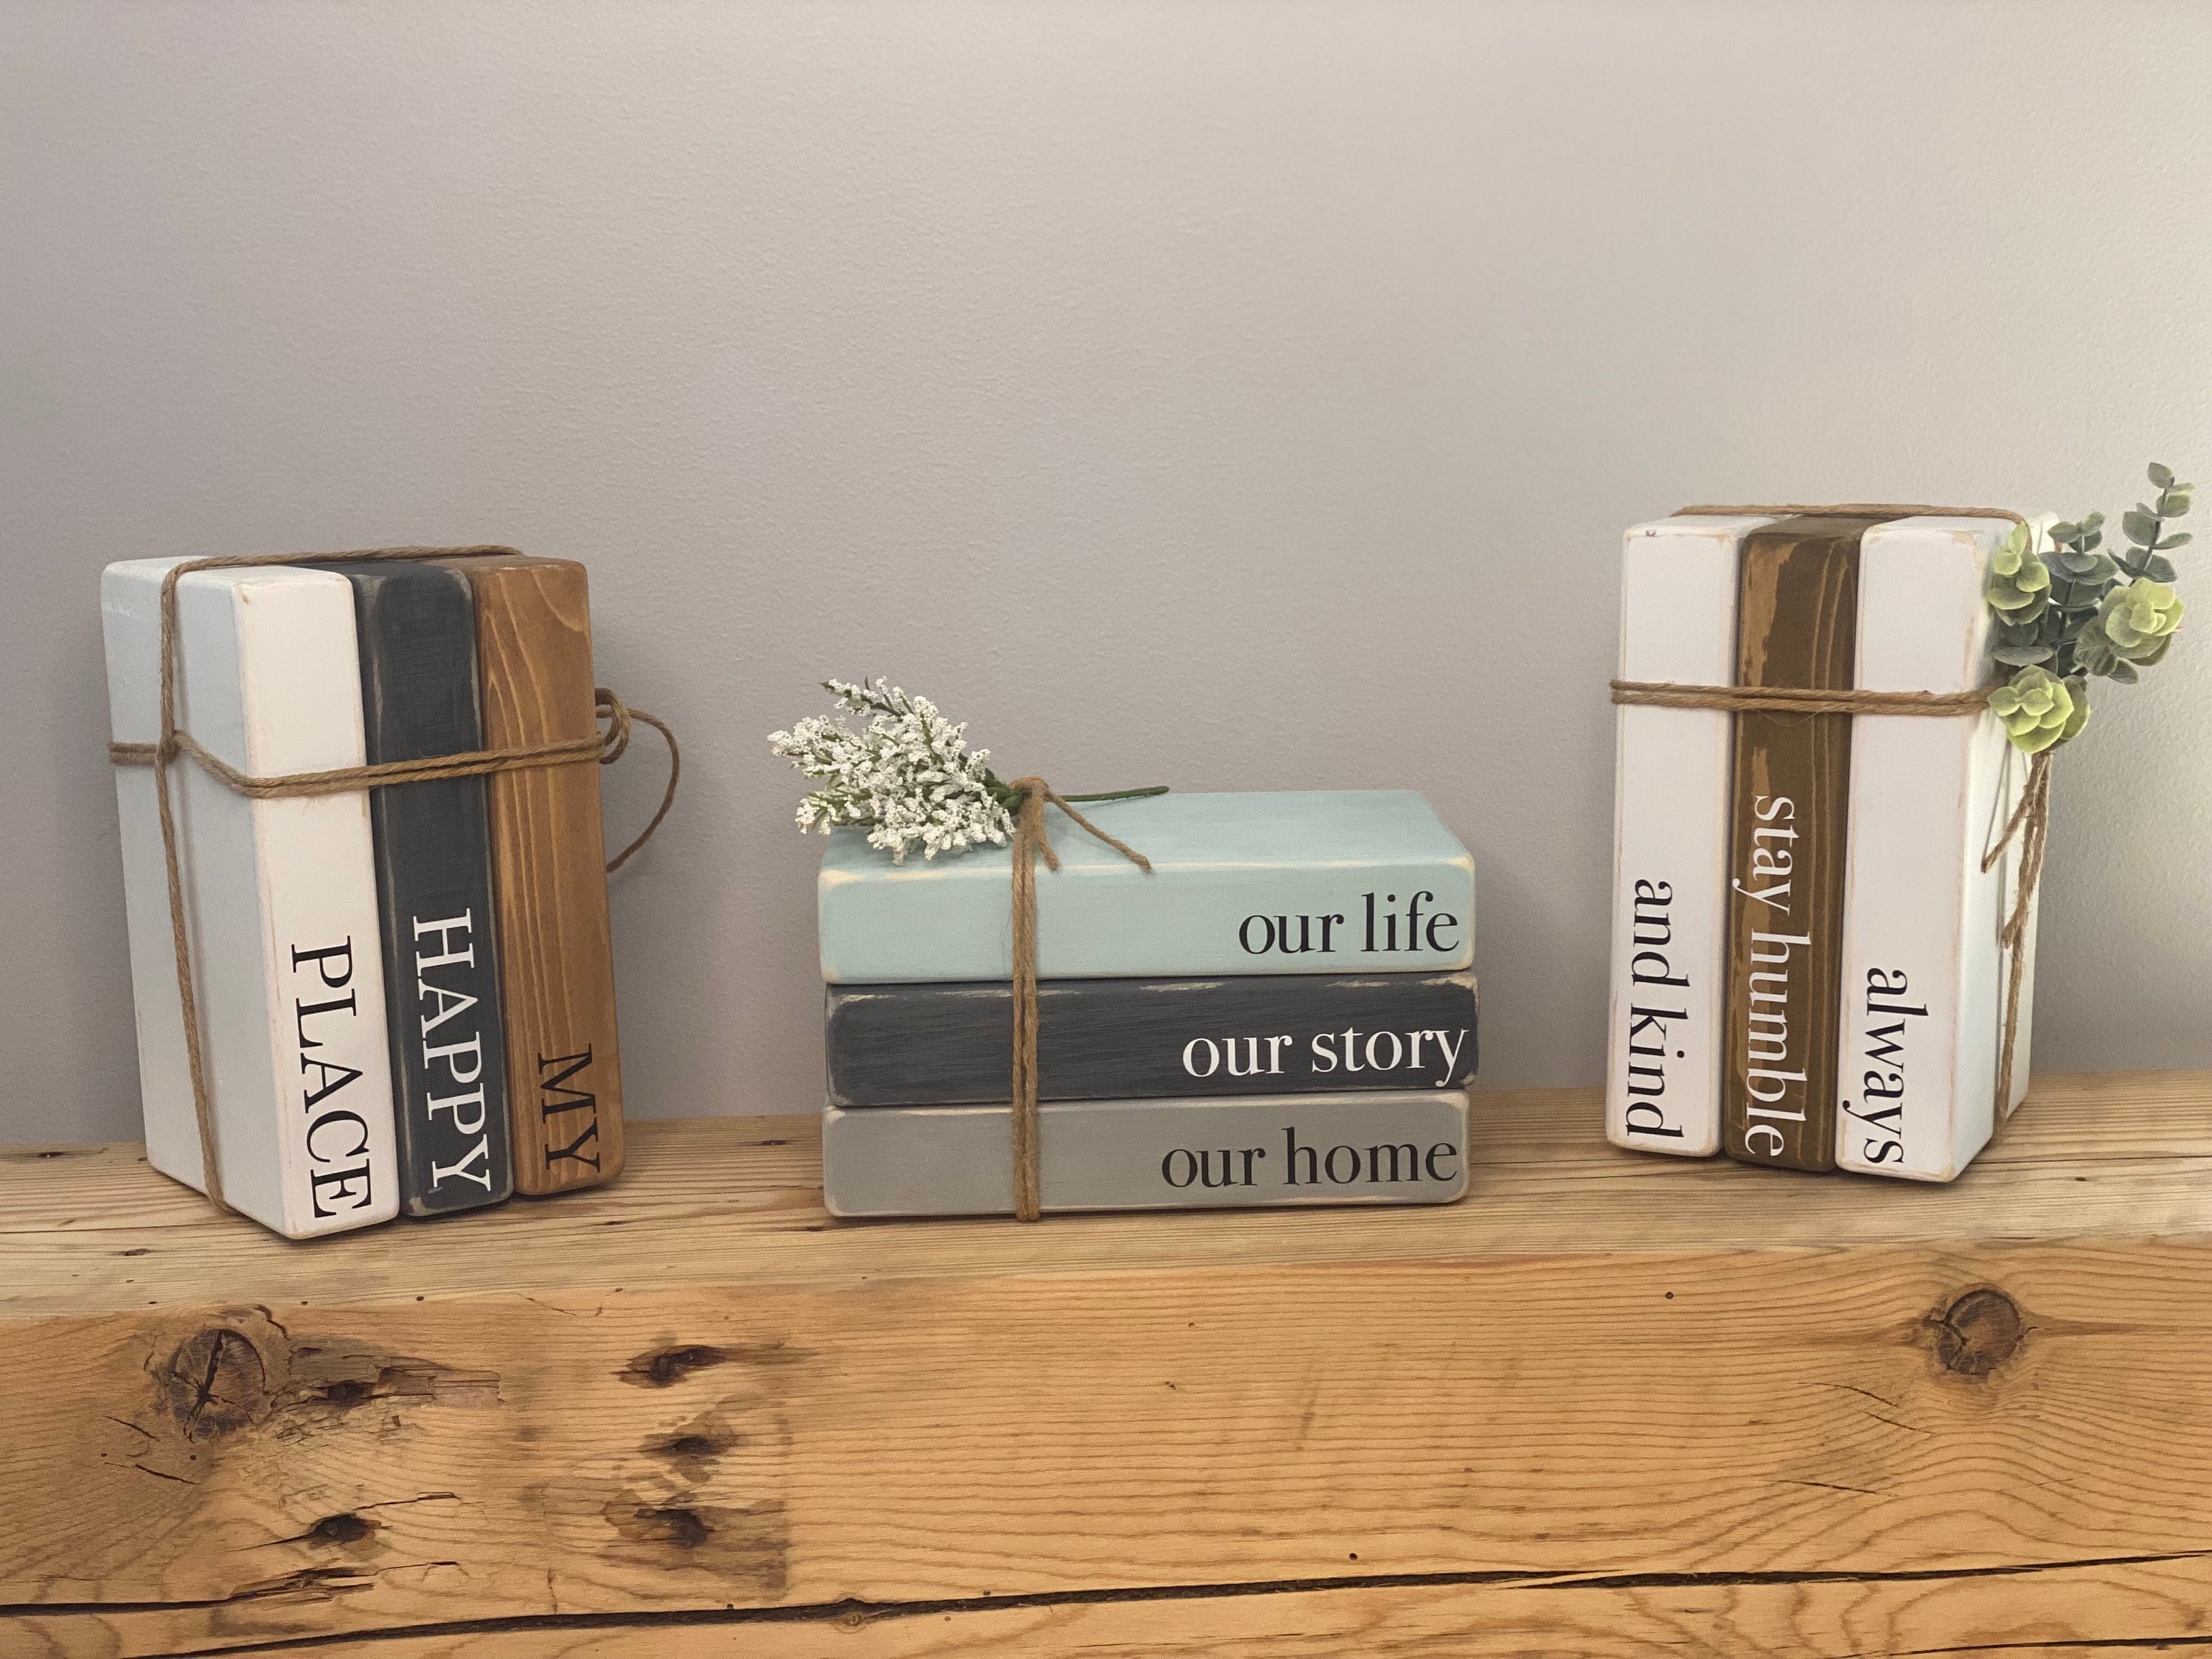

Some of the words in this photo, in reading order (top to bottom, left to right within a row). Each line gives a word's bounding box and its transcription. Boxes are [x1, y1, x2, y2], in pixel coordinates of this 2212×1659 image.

[1733, 795, 1799, 916] stay
[1239, 913, 1343, 954] our
[1360, 891, 1459, 953] life
[1630, 878, 1690, 987] and
[291, 935, 374, 1217] PLACE
[412, 908, 492, 1192] HAPPY
[1181, 1034, 1294, 1077] our
[1311, 1028, 1468, 1088] story
[1625, 1003, 1688, 1138] kind
[1745, 928, 1812, 1157] humble
[1842, 967, 1928, 1164] always
[537, 1043, 600, 1173] MY
[1161, 1147, 1265, 1188] our
[1283, 1127, 1458, 1186] home
